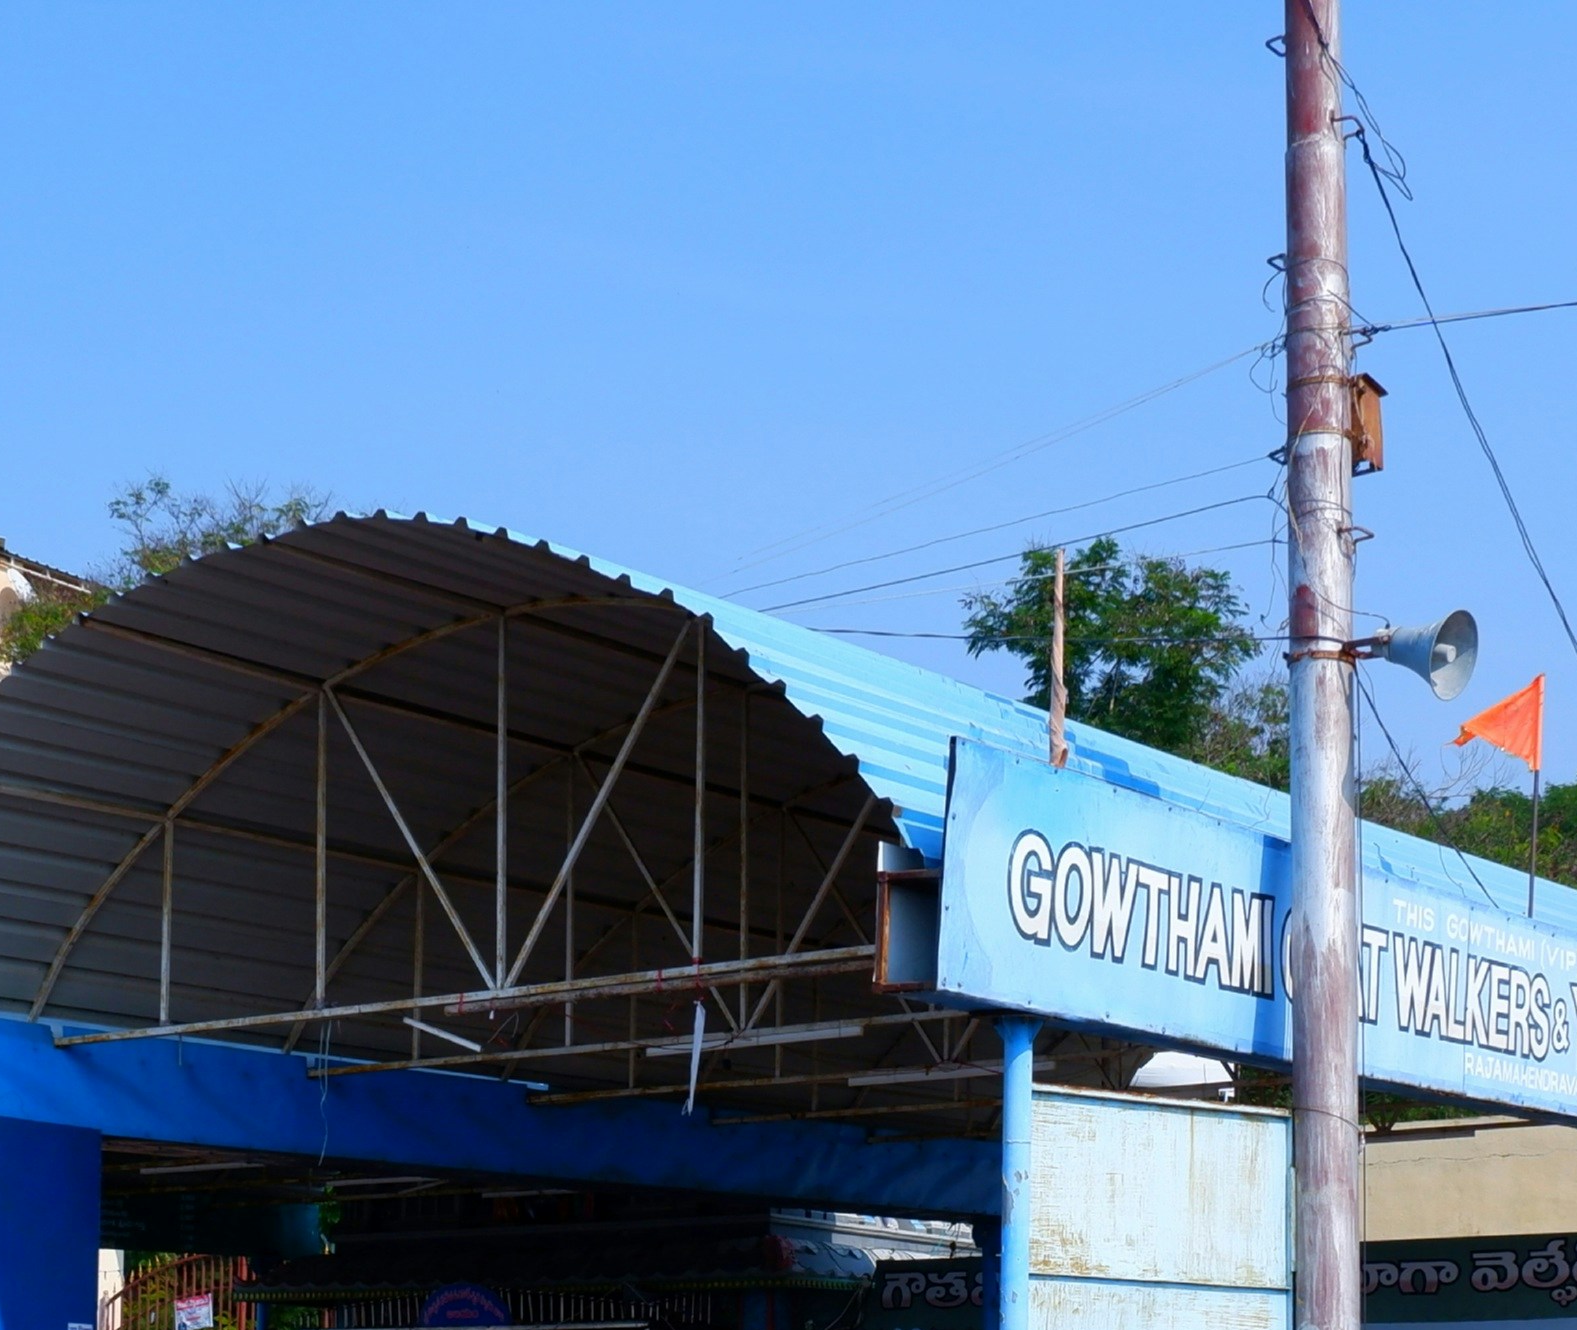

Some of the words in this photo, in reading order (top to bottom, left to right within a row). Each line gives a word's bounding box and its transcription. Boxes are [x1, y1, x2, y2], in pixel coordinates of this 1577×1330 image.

[1008, 829, 1276, 1001] GOWTHAMI
[1392, 931, 1551, 1063] WALKERS
[1551, 997, 1571, 1053] &
[1392, 898, 1435, 933] THIS
[1446, 911, 1536, 962] GOWTHAMI
